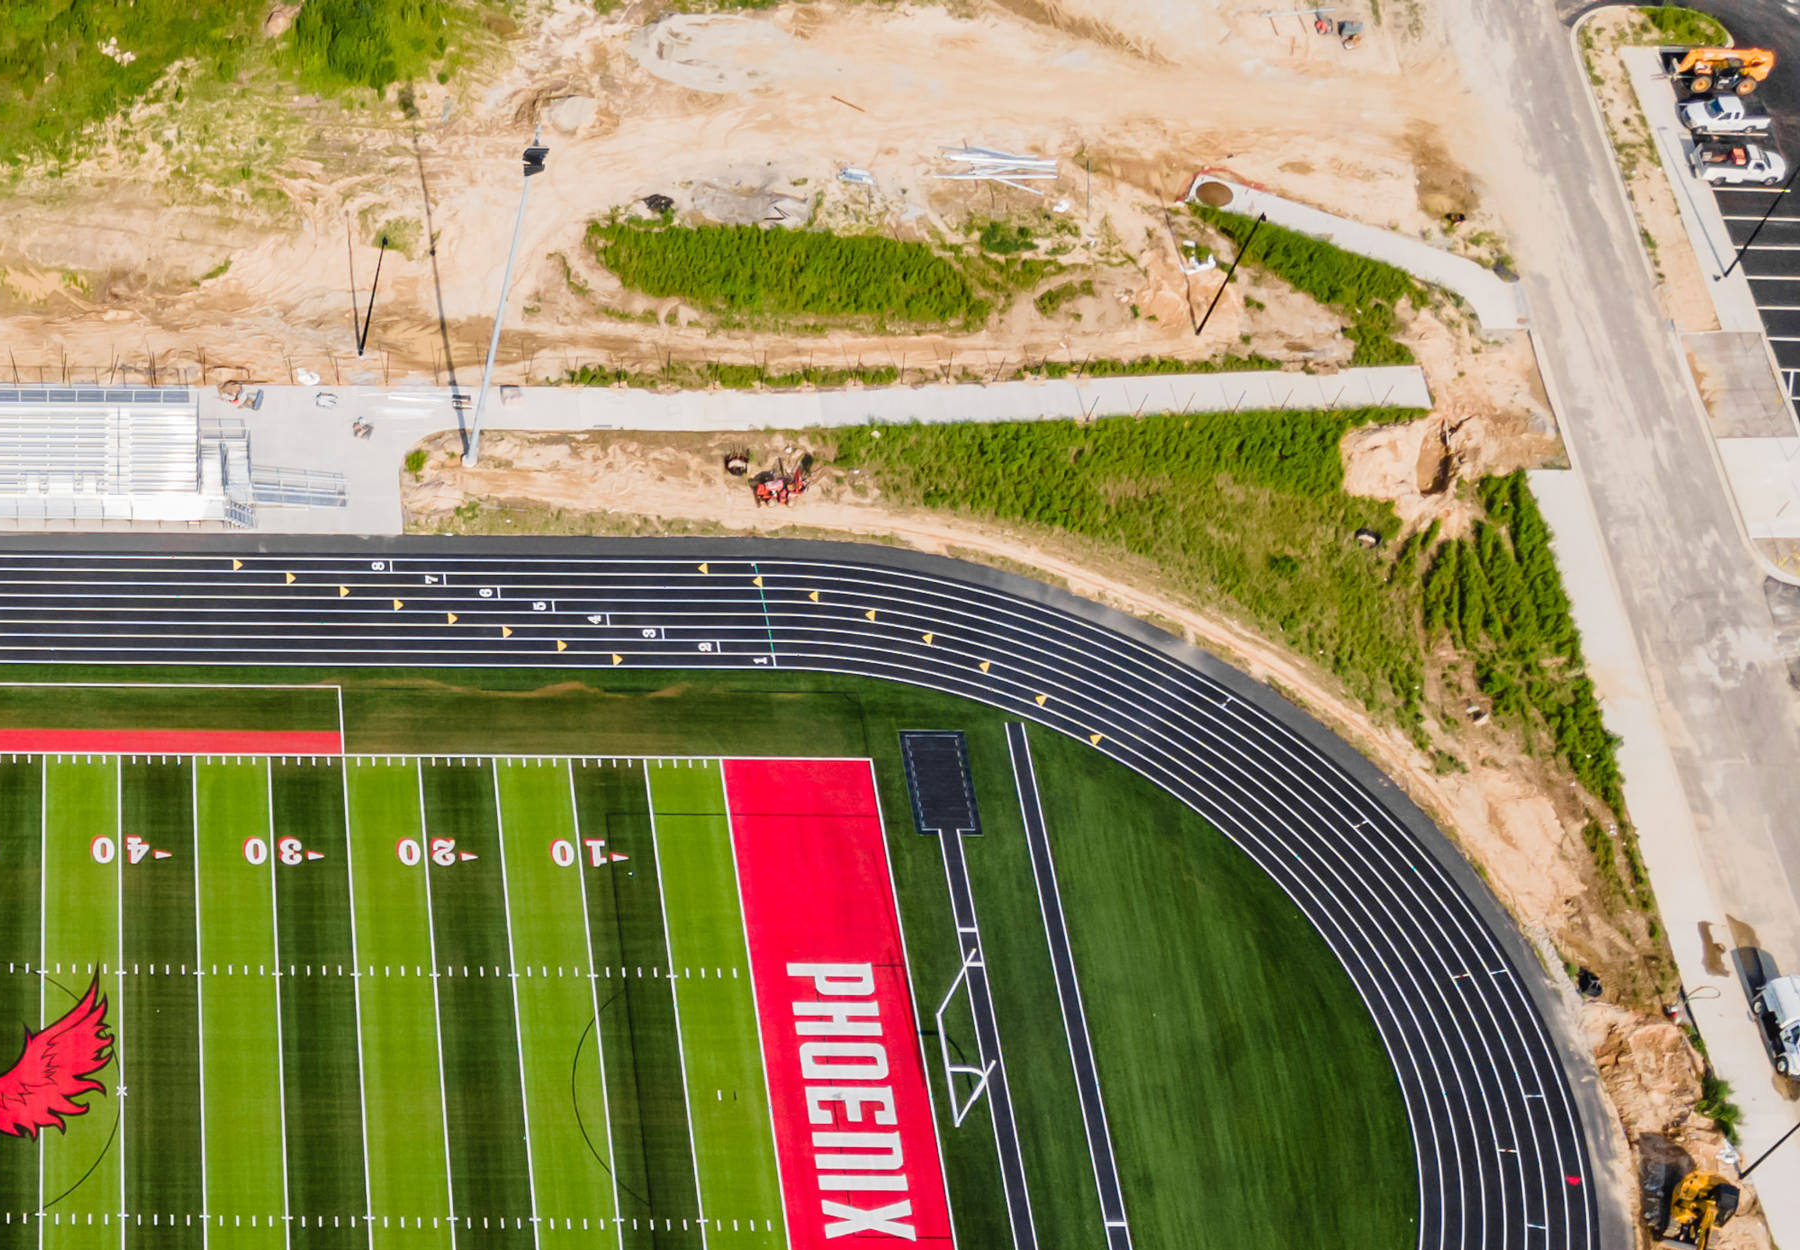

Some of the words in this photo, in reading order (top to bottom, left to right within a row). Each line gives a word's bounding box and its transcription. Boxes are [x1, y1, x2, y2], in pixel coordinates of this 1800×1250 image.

[372, 562, 385, 570] 8
[425, 575, 438, 584] 7
[479, 588, 492, 597] 6
[533, 602, 546, 610] 5
[587, 615, 601, 624] 4
[642, 629, 656, 638] 3
[698, 642, 712, 651] 2
[91, 836, 150, 865] 40
[243, 837, 303, 866] 30
[397, 838, 456, 867] 20
[551, 838, 608, 868] 10
[785, 960, 918, 1243] PHOENIX
